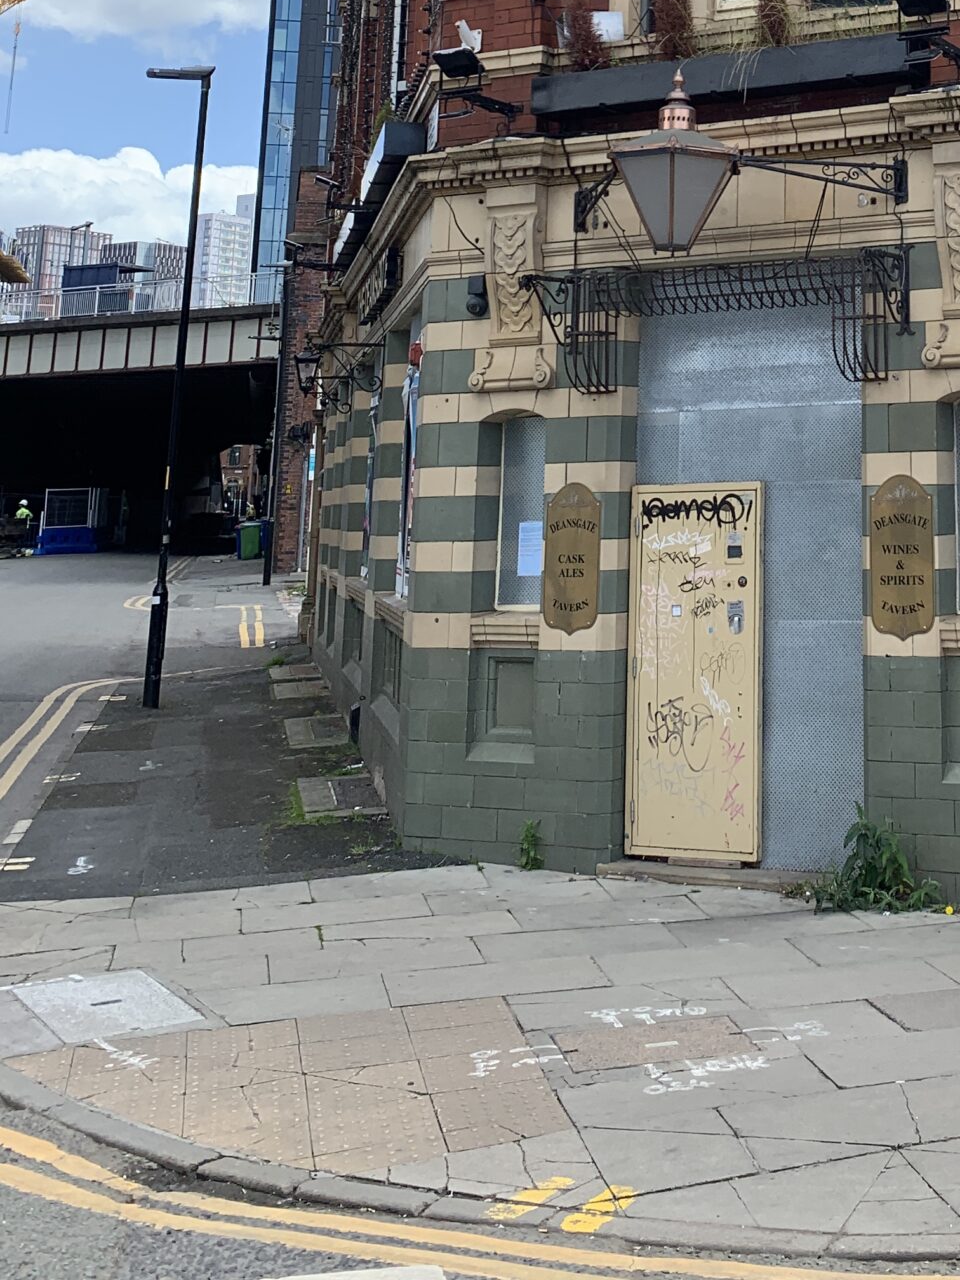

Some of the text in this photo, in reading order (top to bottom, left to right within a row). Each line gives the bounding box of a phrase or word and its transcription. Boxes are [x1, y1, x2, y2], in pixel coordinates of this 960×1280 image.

[549, 518, 598, 534] DEANSGATE
[874, 512, 929, 530] DEANSGATE
[881, 544, 920, 554] WINES
[558, 554, 585, 564] CASK
[895, 560, 905, 570] &
[558, 568, 585, 578] ALES
[879, 575, 925, 586] SPIRITS
[552, 598, 590, 612] TAVERN
[881, 600, 926, 615] TAVERN
